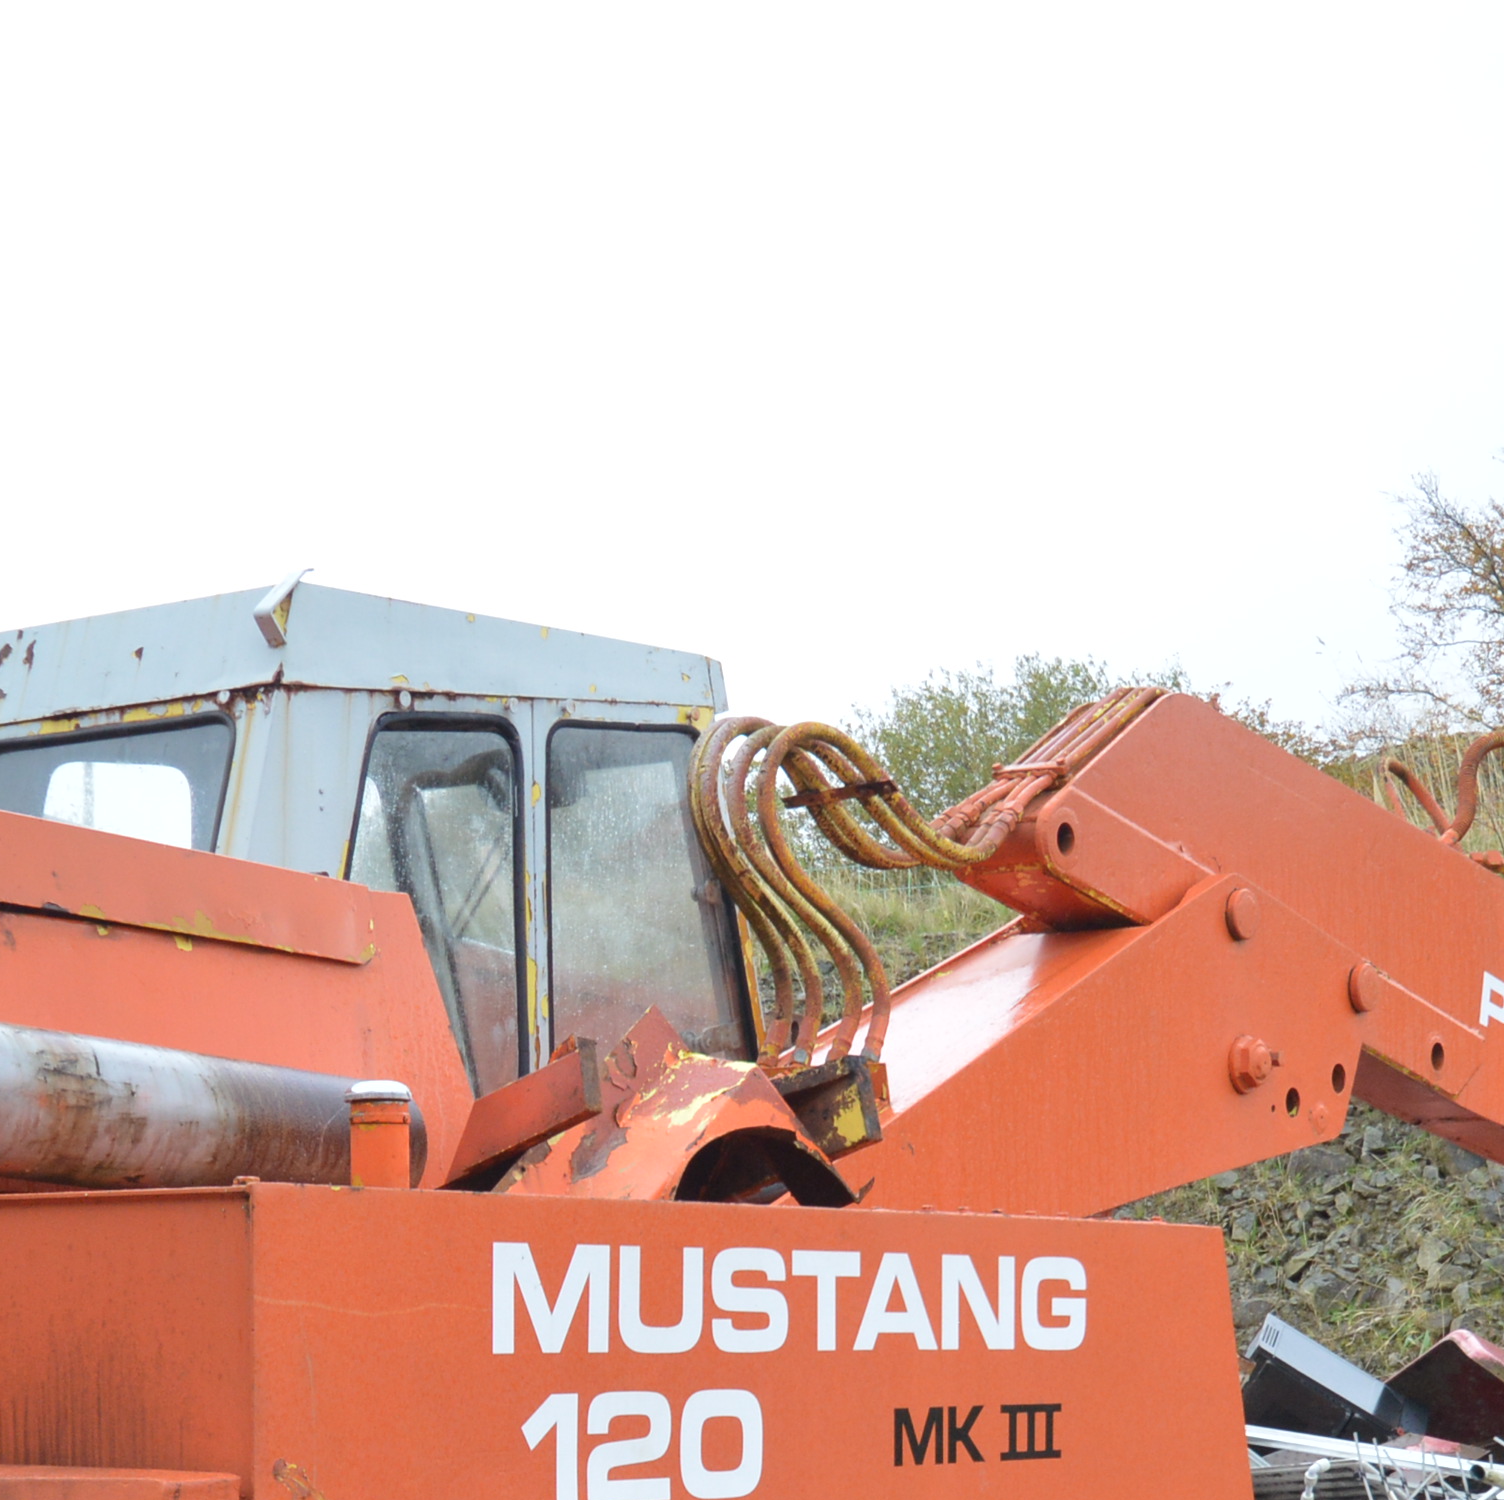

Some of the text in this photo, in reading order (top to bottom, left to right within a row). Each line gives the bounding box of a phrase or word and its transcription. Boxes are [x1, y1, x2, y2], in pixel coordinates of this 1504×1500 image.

[492, 1242, 1088, 1354] MUSTANG
[894, 1405, 985, 1466] MK
[1001, 1403, 1062, 1460] III
